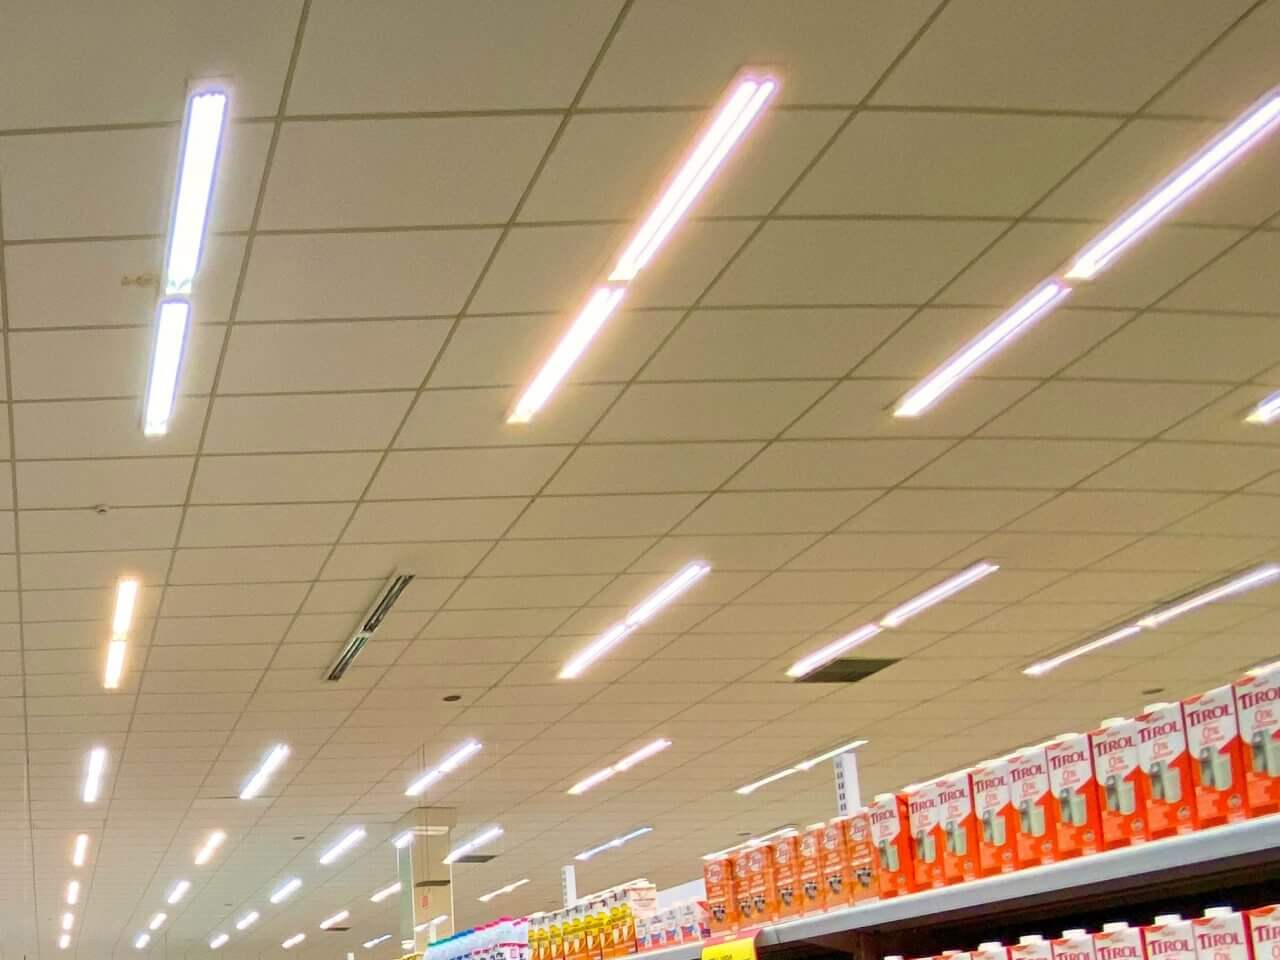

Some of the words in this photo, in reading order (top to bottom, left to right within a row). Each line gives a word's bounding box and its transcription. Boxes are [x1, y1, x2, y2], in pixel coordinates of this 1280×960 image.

[1187, 702, 1233, 727] TIROL
[1138, 720, 1181, 744] TIROL
[1095, 734, 1136, 757] TIROL
[1050, 748, 1087, 770] TIROL
[1010, 762, 1045, 783] TIROL
[974, 774, 1006, 794] TIROL
[938, 787, 968, 805] TIROL
[871, 807, 896, 825] TIROL
[910, 798, 937, 815] TIROL
[1198, 931, 1243, 950] TIROL
[1255, 924, 1280, 942] TIR
[1148, 938, 1193, 956] TIROL
